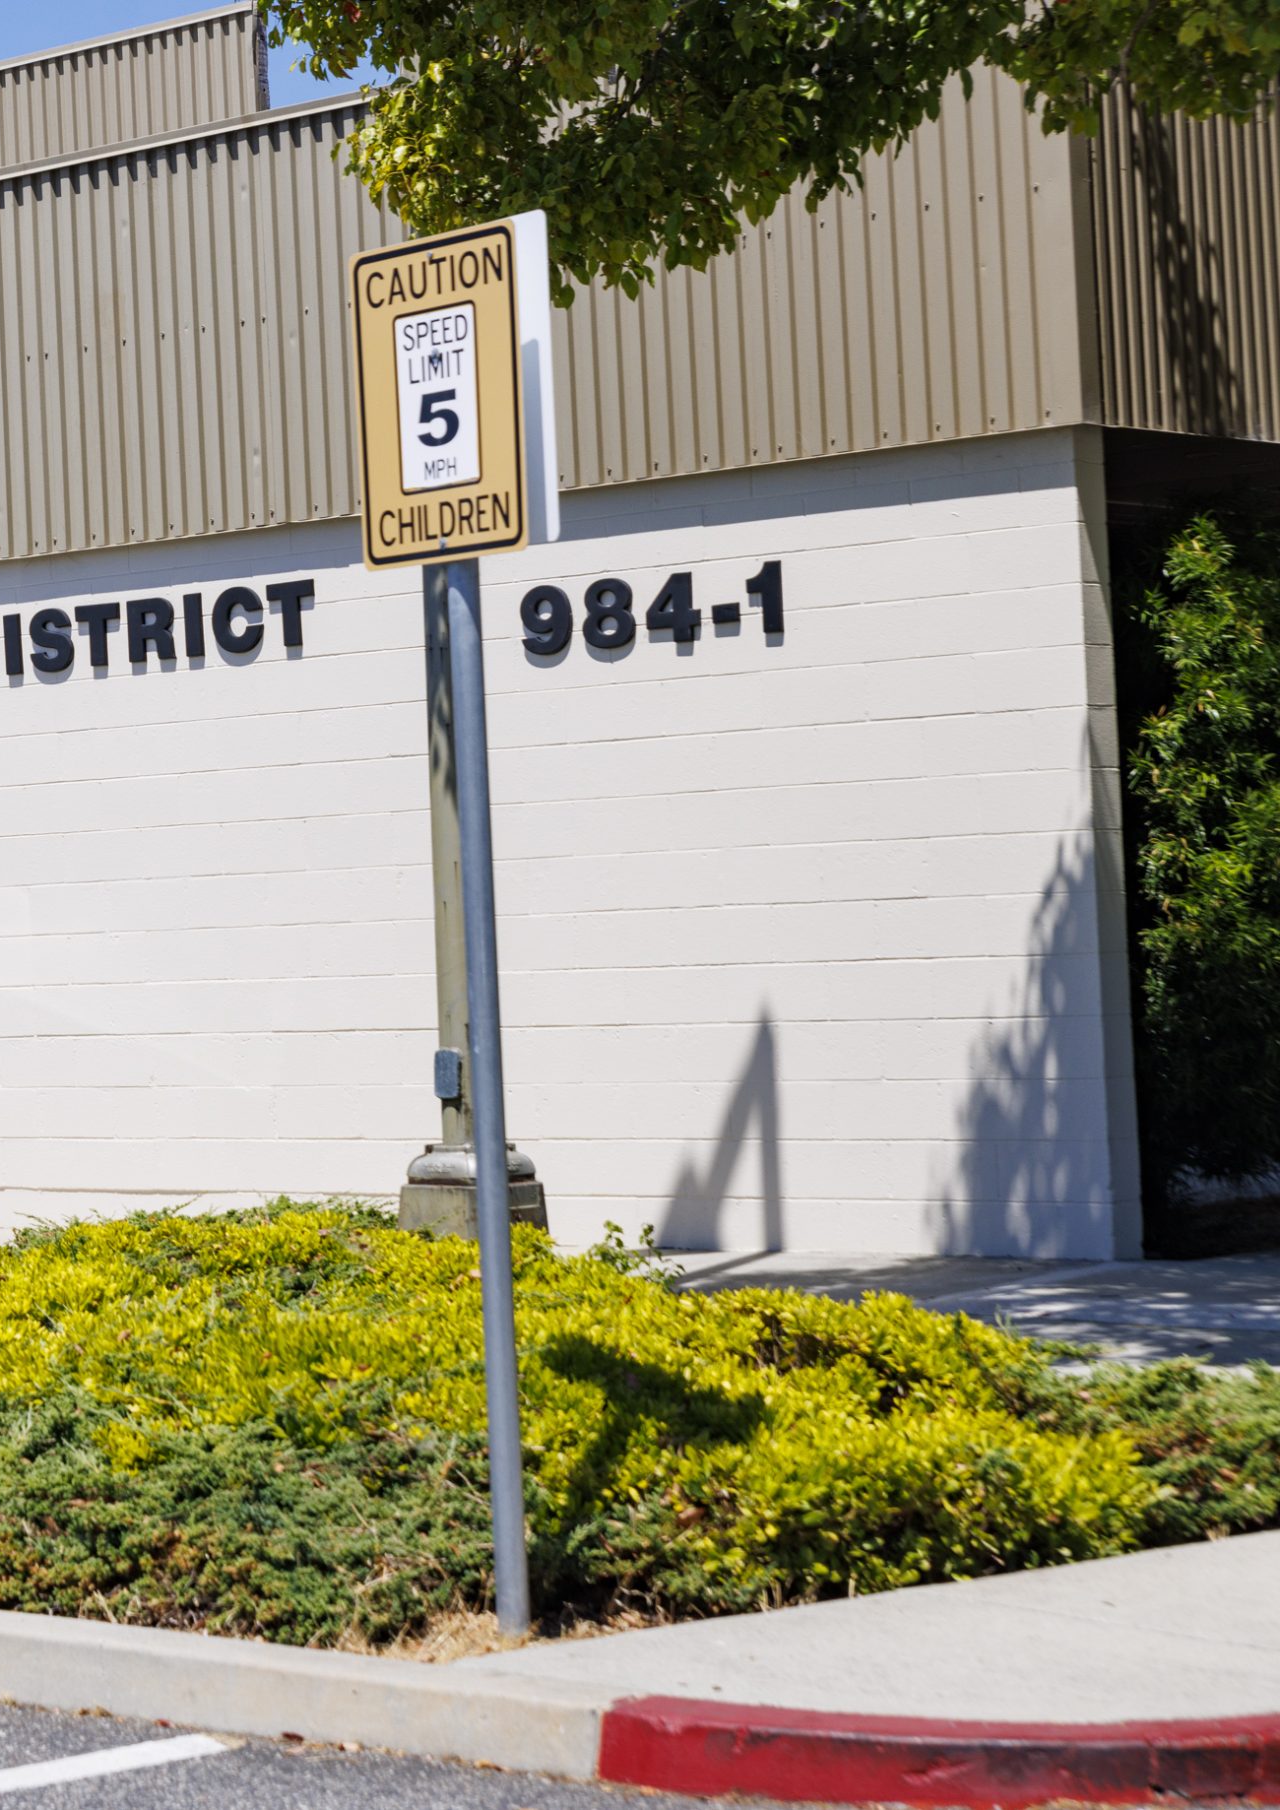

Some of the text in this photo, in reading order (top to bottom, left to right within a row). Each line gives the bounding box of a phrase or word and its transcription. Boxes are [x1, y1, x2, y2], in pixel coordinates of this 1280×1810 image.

[366, 243, 504, 309] CAUTION
[403, 314, 468, 352] SPEED
[408, 348, 465, 385] LIMIT
[417, 388, 460, 447] 5
[423, 456, 458, 481] MPH
[379, 491, 511, 547] CHILDREN
[519, 559, 785, 656] 984-1
